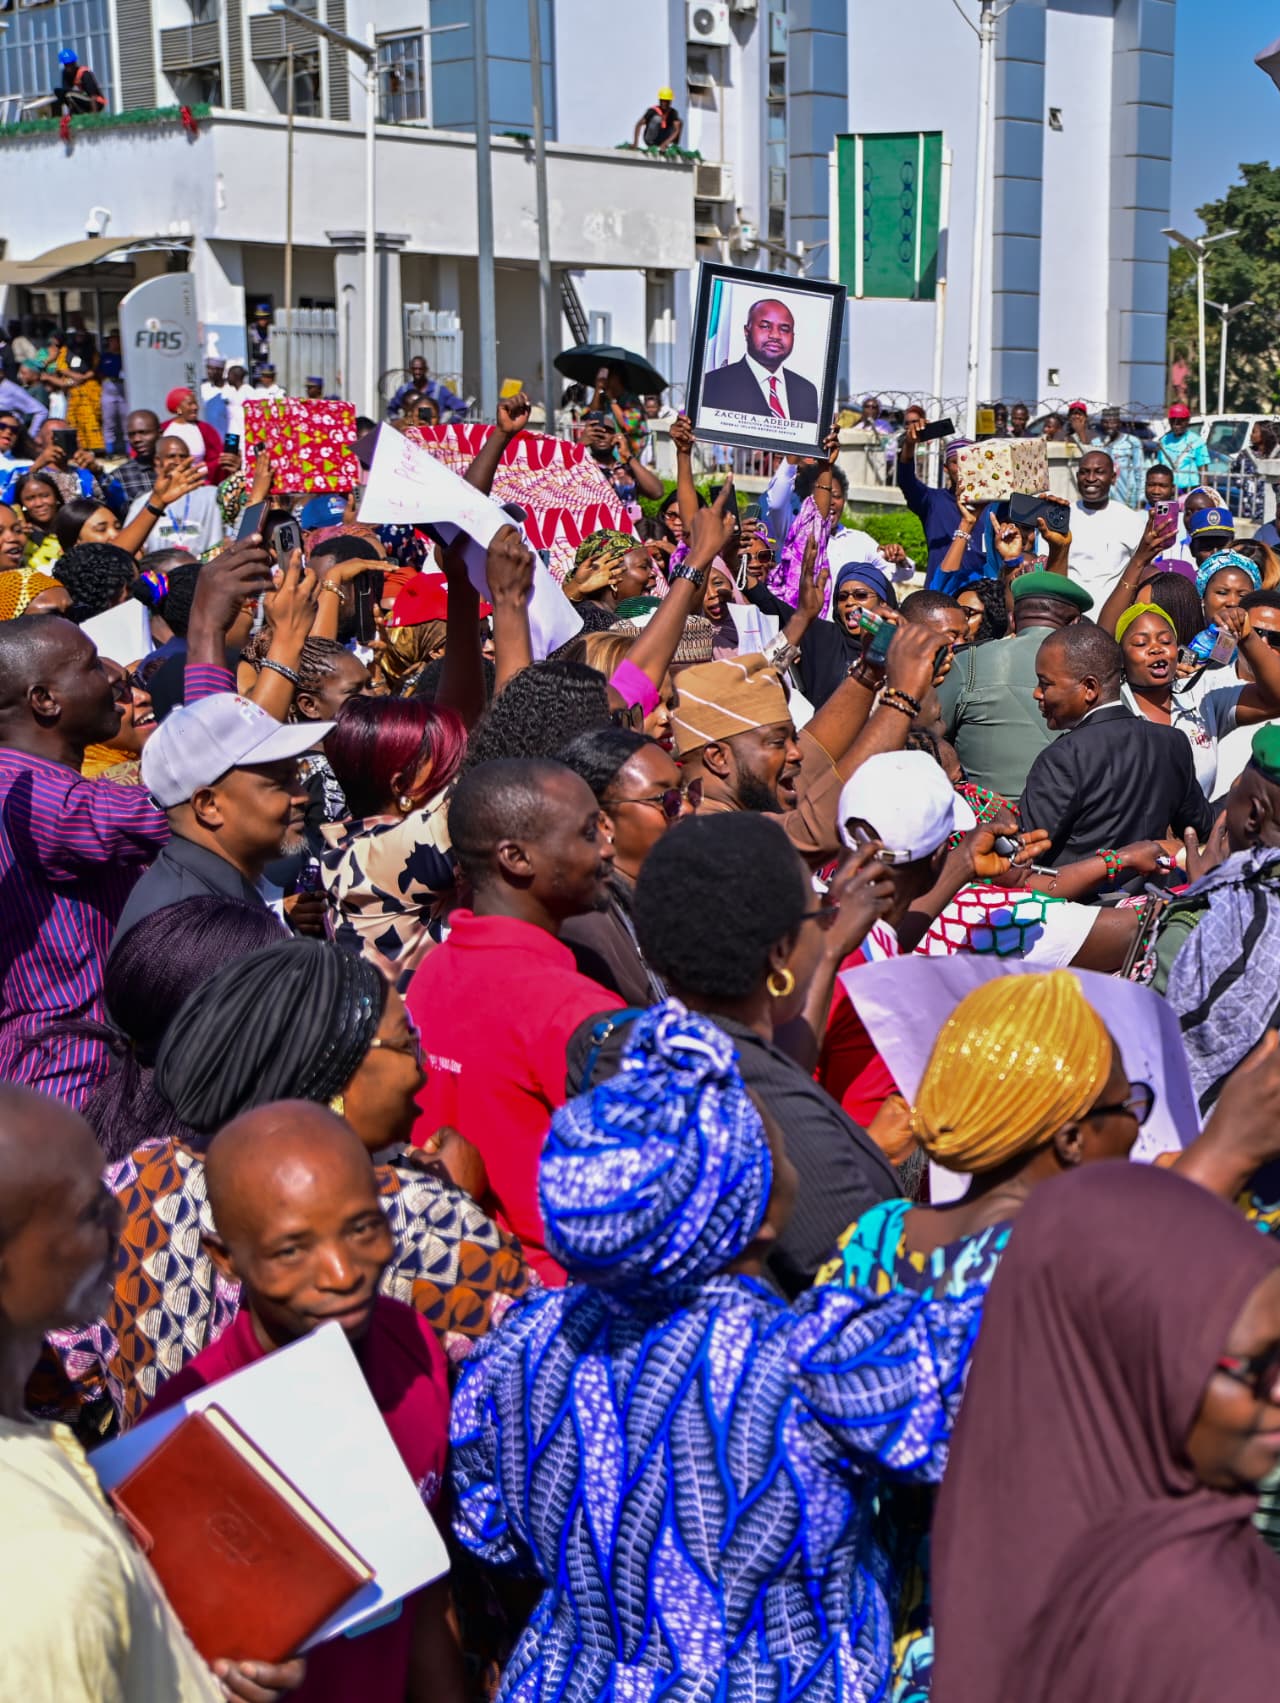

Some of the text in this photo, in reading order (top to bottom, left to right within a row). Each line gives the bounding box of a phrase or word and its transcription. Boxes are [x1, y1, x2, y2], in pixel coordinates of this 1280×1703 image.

[135, 331, 183, 350] FIRS
[714, 410, 748, 422] ZACCH
[763, 417, 804, 429] ADEDEJI
